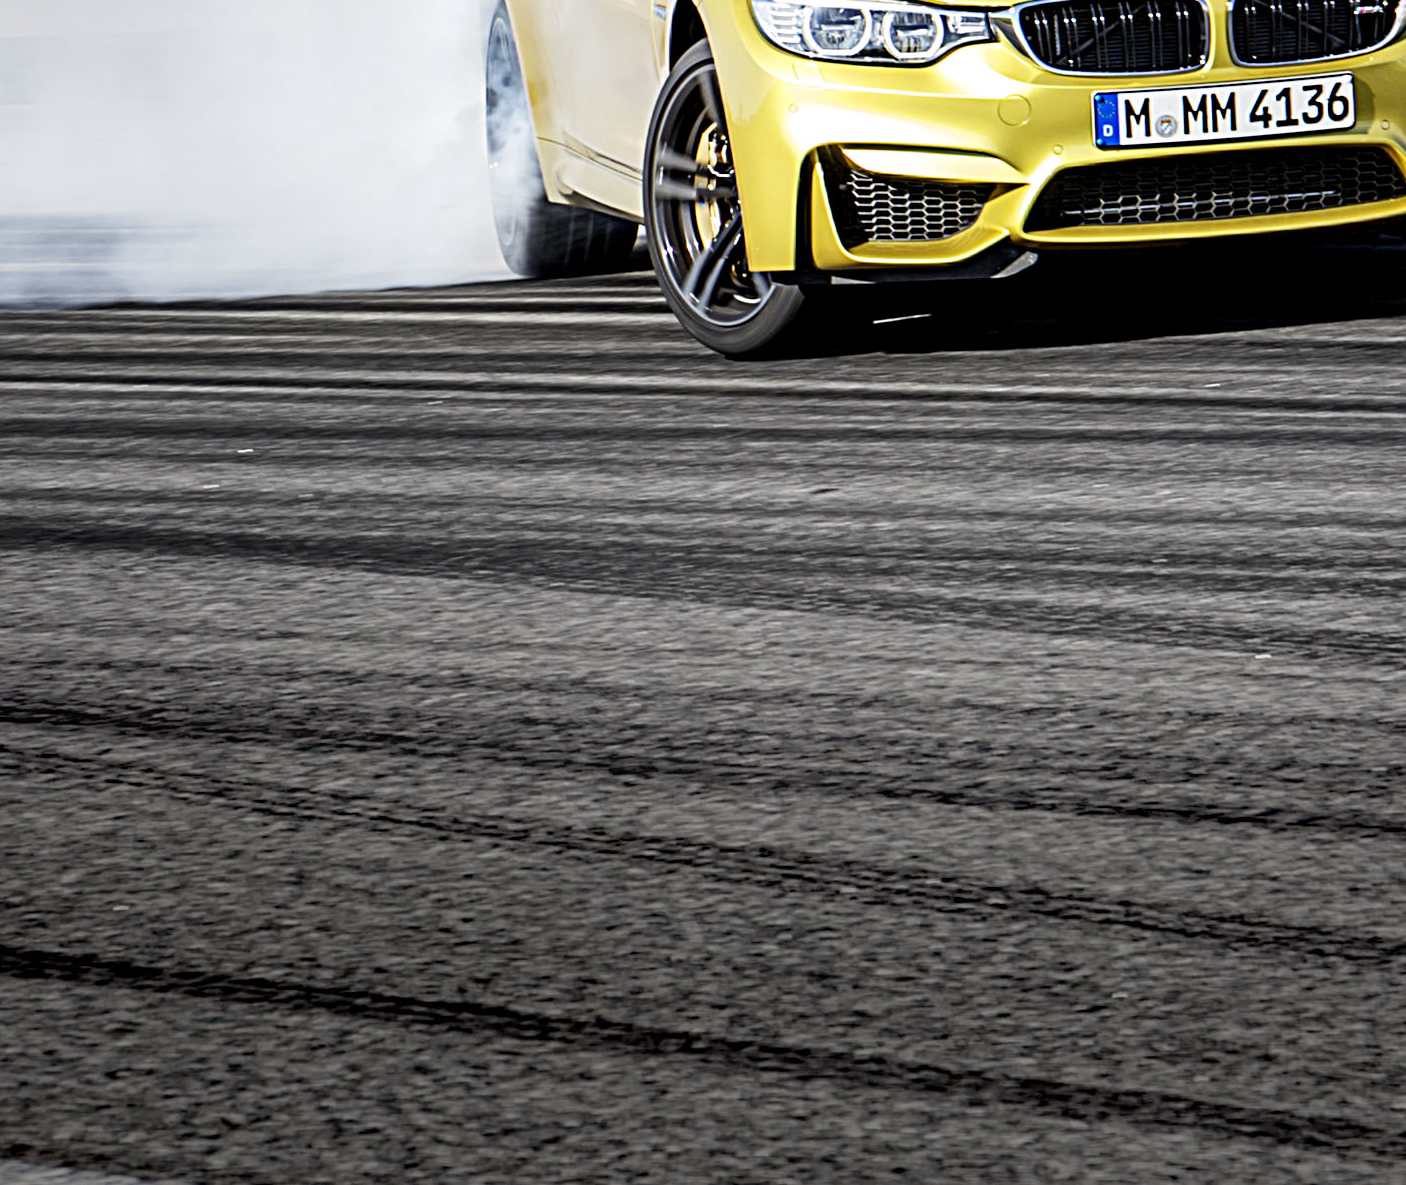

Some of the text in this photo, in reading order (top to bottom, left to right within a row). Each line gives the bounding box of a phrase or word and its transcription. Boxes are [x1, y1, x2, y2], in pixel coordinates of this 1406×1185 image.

[1124, 82, 1350, 138] M MM 4136
[1102, 124, 1114, 137] D
